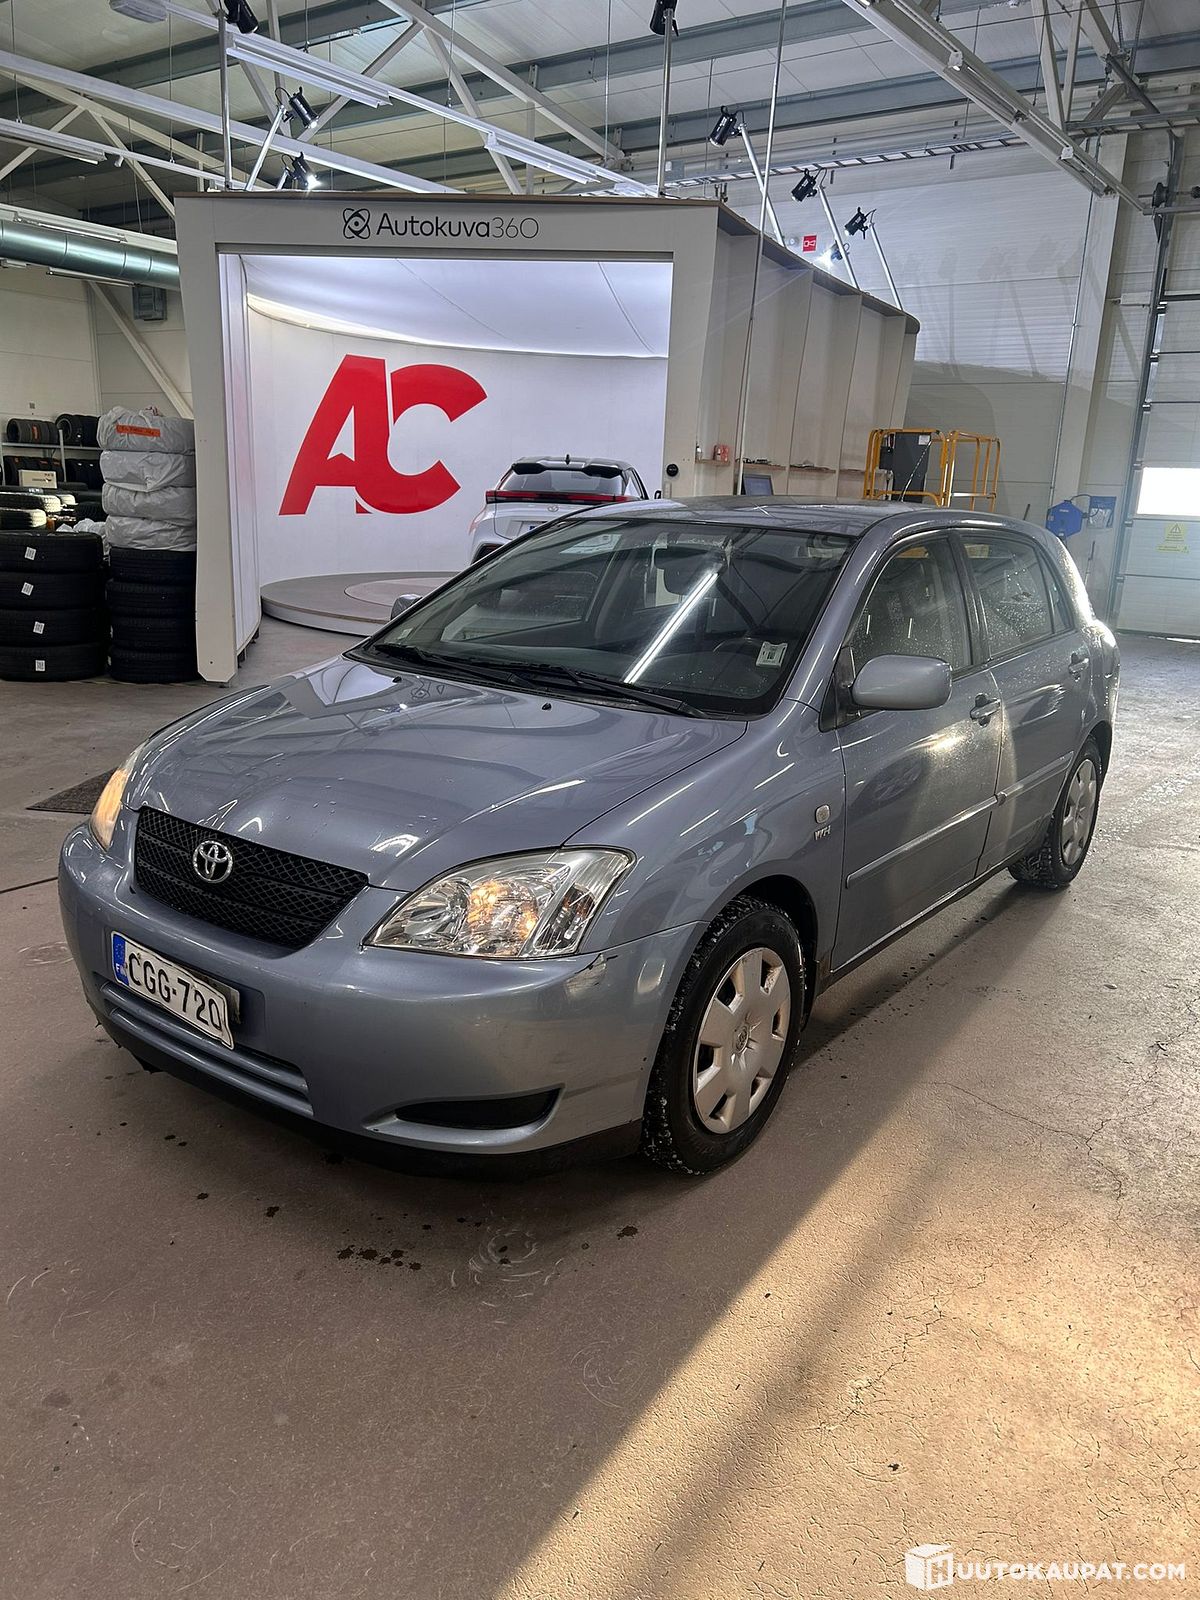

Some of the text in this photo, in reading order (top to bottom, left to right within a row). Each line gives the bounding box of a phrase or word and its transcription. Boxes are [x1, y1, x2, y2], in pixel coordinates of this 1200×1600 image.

[376, 212, 539, 239] Autokuva360
[278, 353, 488, 516] AC
[128, 952, 223, 1032] CGG-720
